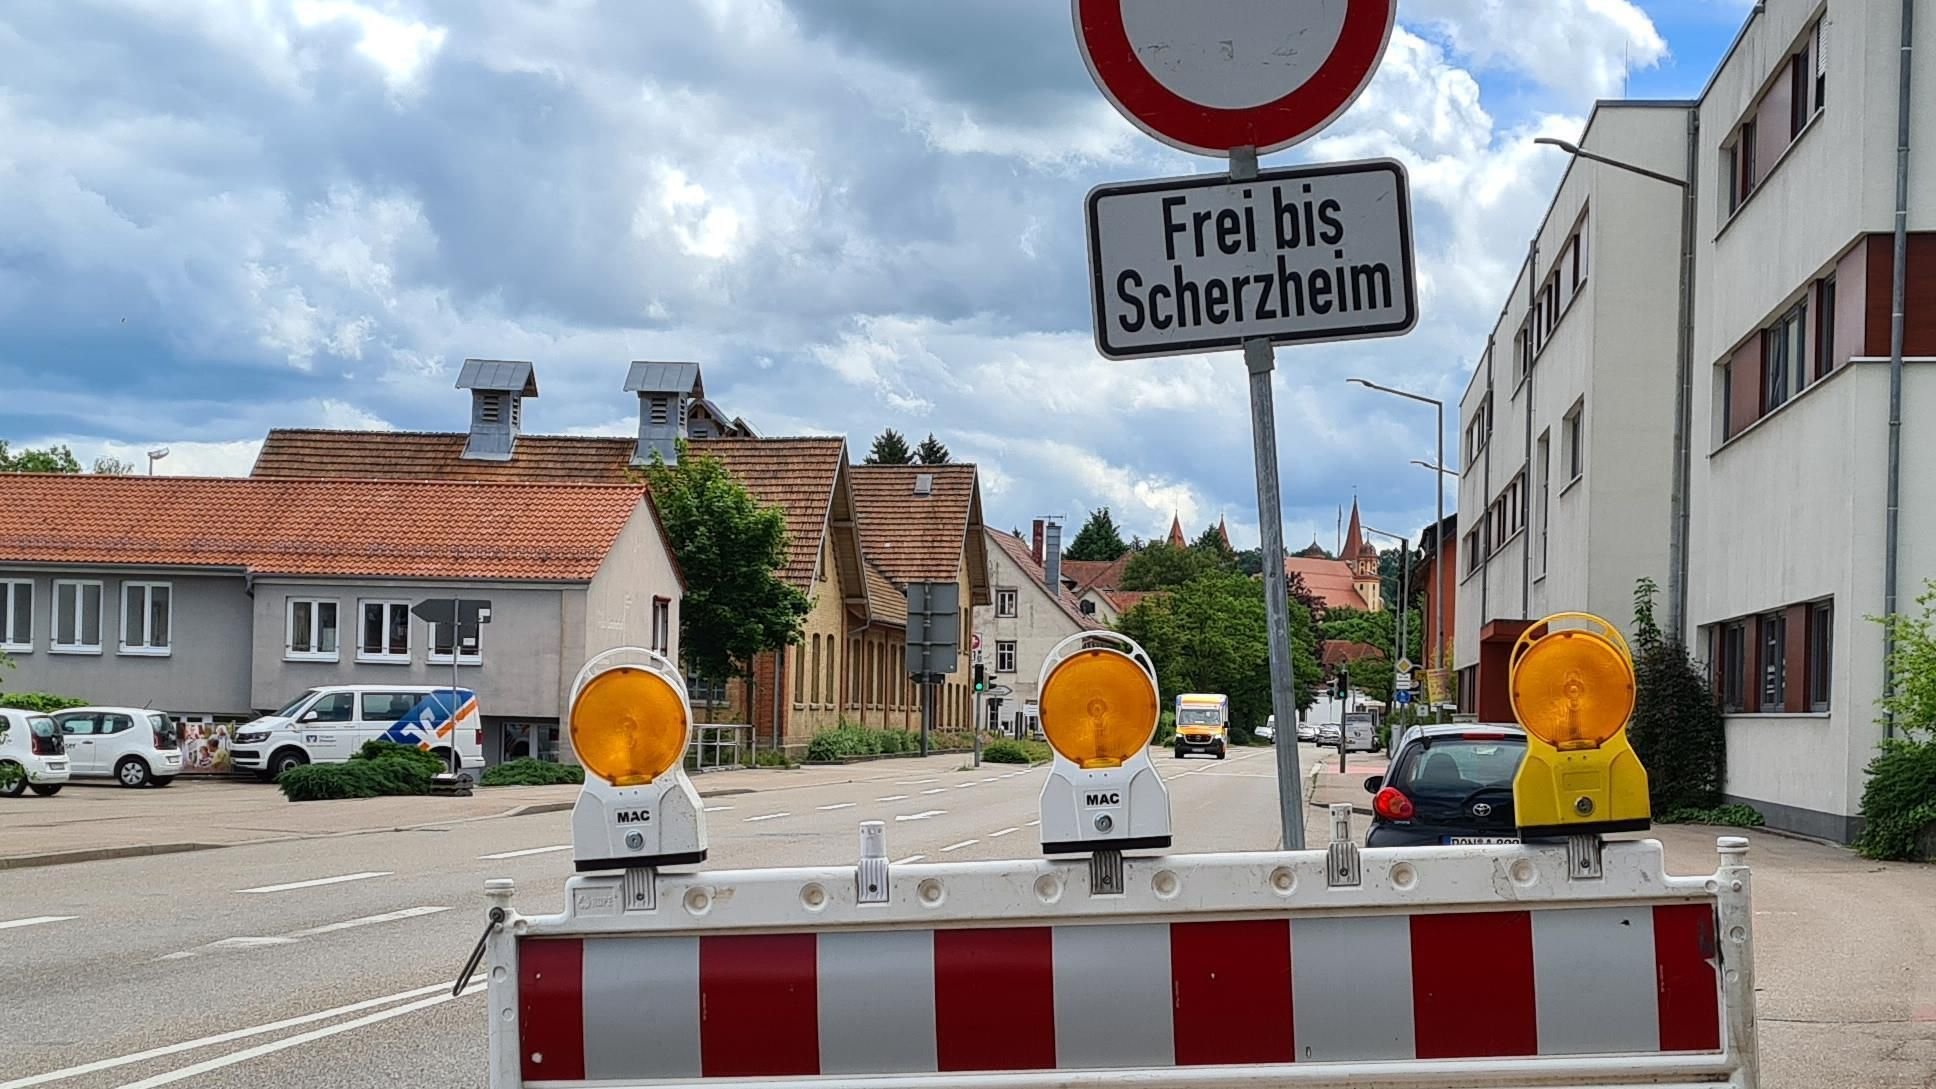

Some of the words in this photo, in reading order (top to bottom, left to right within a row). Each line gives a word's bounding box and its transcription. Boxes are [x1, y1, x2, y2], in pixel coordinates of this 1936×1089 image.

[1162, 189, 1256, 261] Frei
[1272, 183, 1344, 250] bis
[1116, 249, 1392, 333] Scherzheim
[616, 810, 650, 824] MAC
[1086, 793, 1120, 806] MAC
